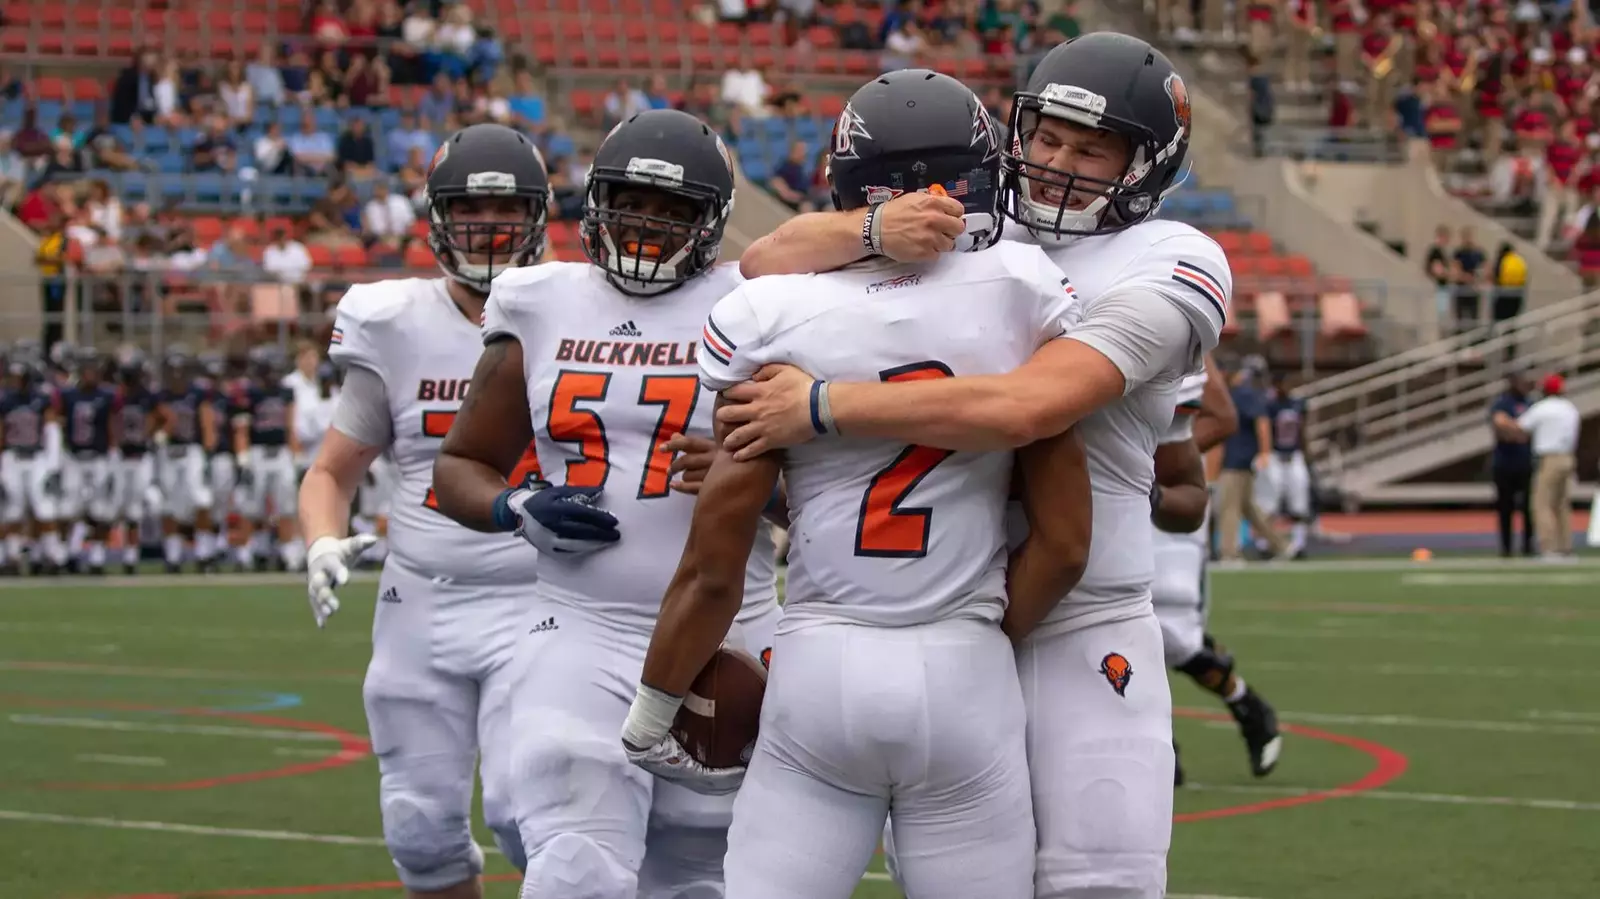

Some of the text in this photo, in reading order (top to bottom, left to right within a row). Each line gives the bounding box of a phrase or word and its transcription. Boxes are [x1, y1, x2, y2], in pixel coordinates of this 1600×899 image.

[862, 212, 874, 239] LEAVE
[862, 238, 871, 246] A
[555, 338, 698, 366] BUCKNELL
[546, 368, 701, 500] 57
[854, 360, 958, 559] 2
